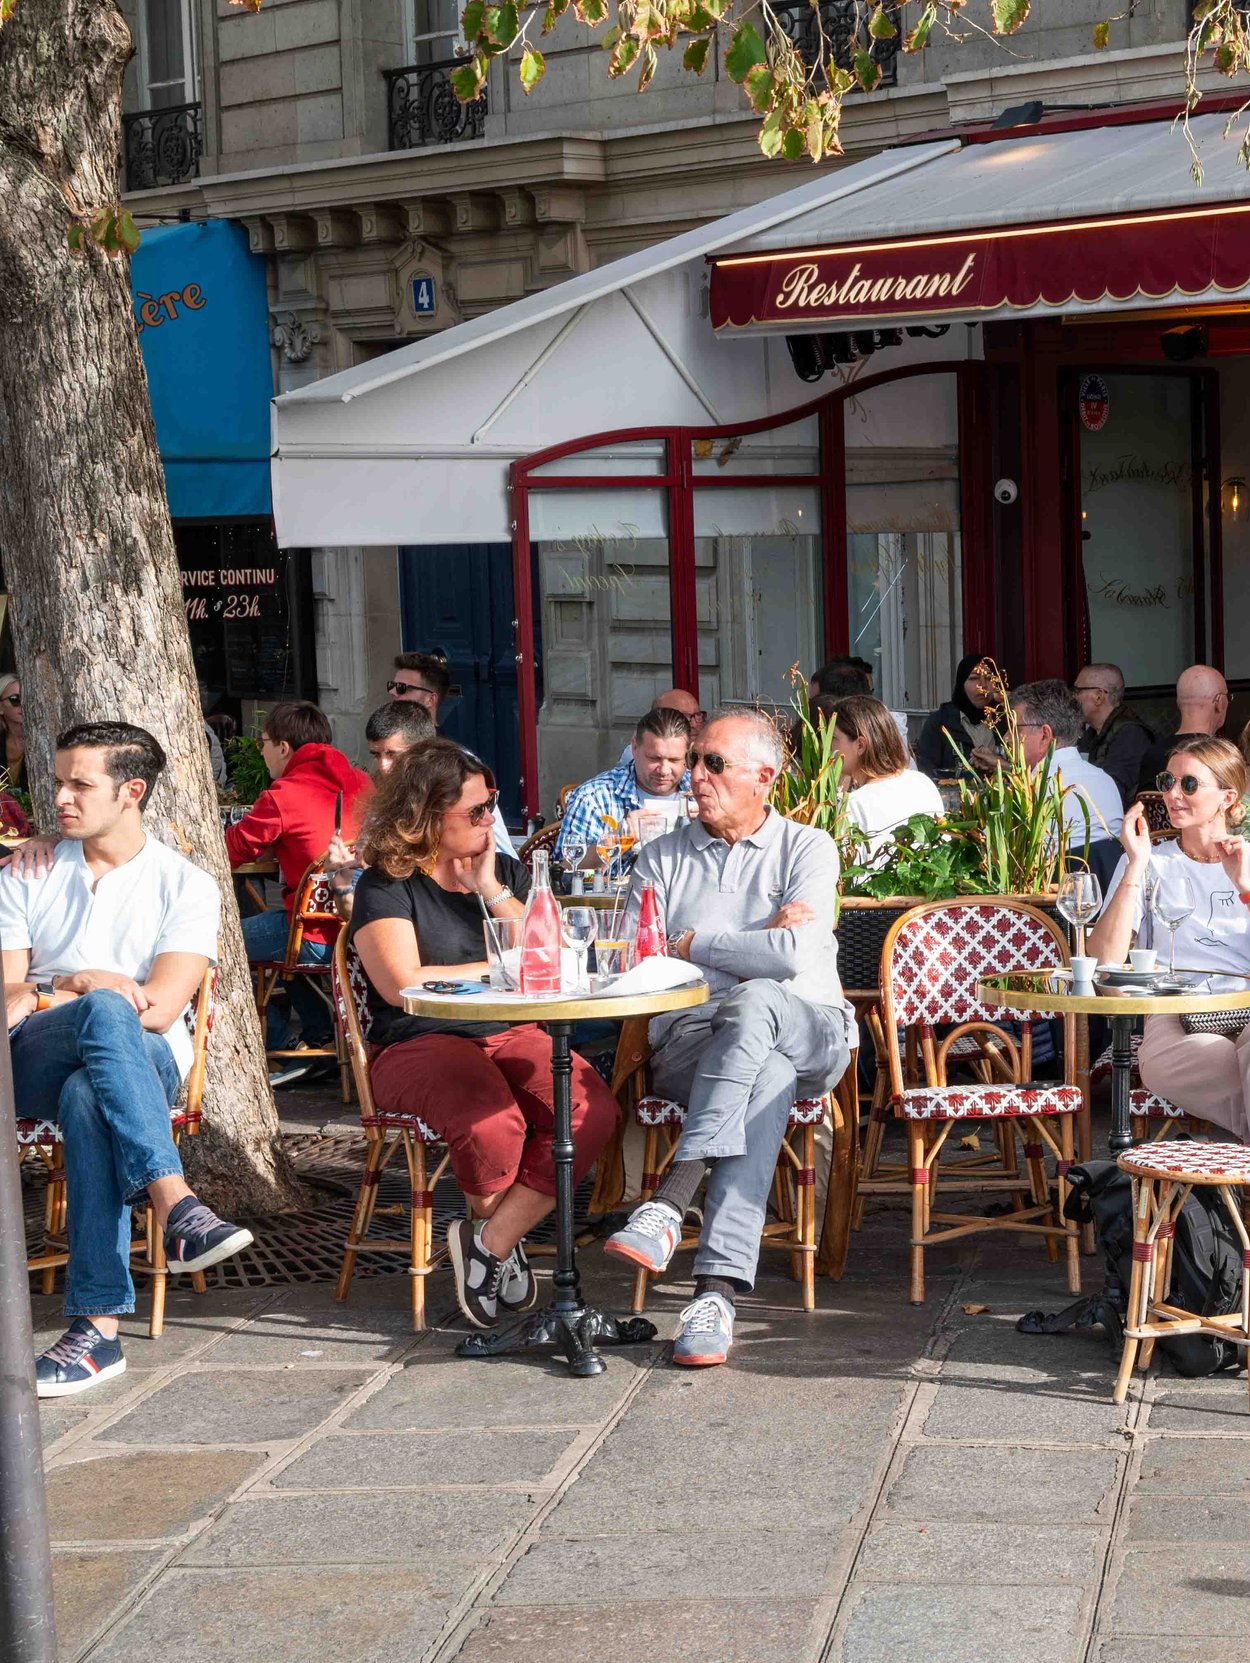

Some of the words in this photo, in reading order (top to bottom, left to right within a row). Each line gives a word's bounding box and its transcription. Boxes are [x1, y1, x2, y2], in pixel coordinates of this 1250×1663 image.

[418, 281, 430, 308] 4
[775, 252, 977, 309] Restaurant
[136, 282, 207, 334] ère
[180, 570, 215, 586] RVICE
[220, 569, 275, 585] CONTINU
